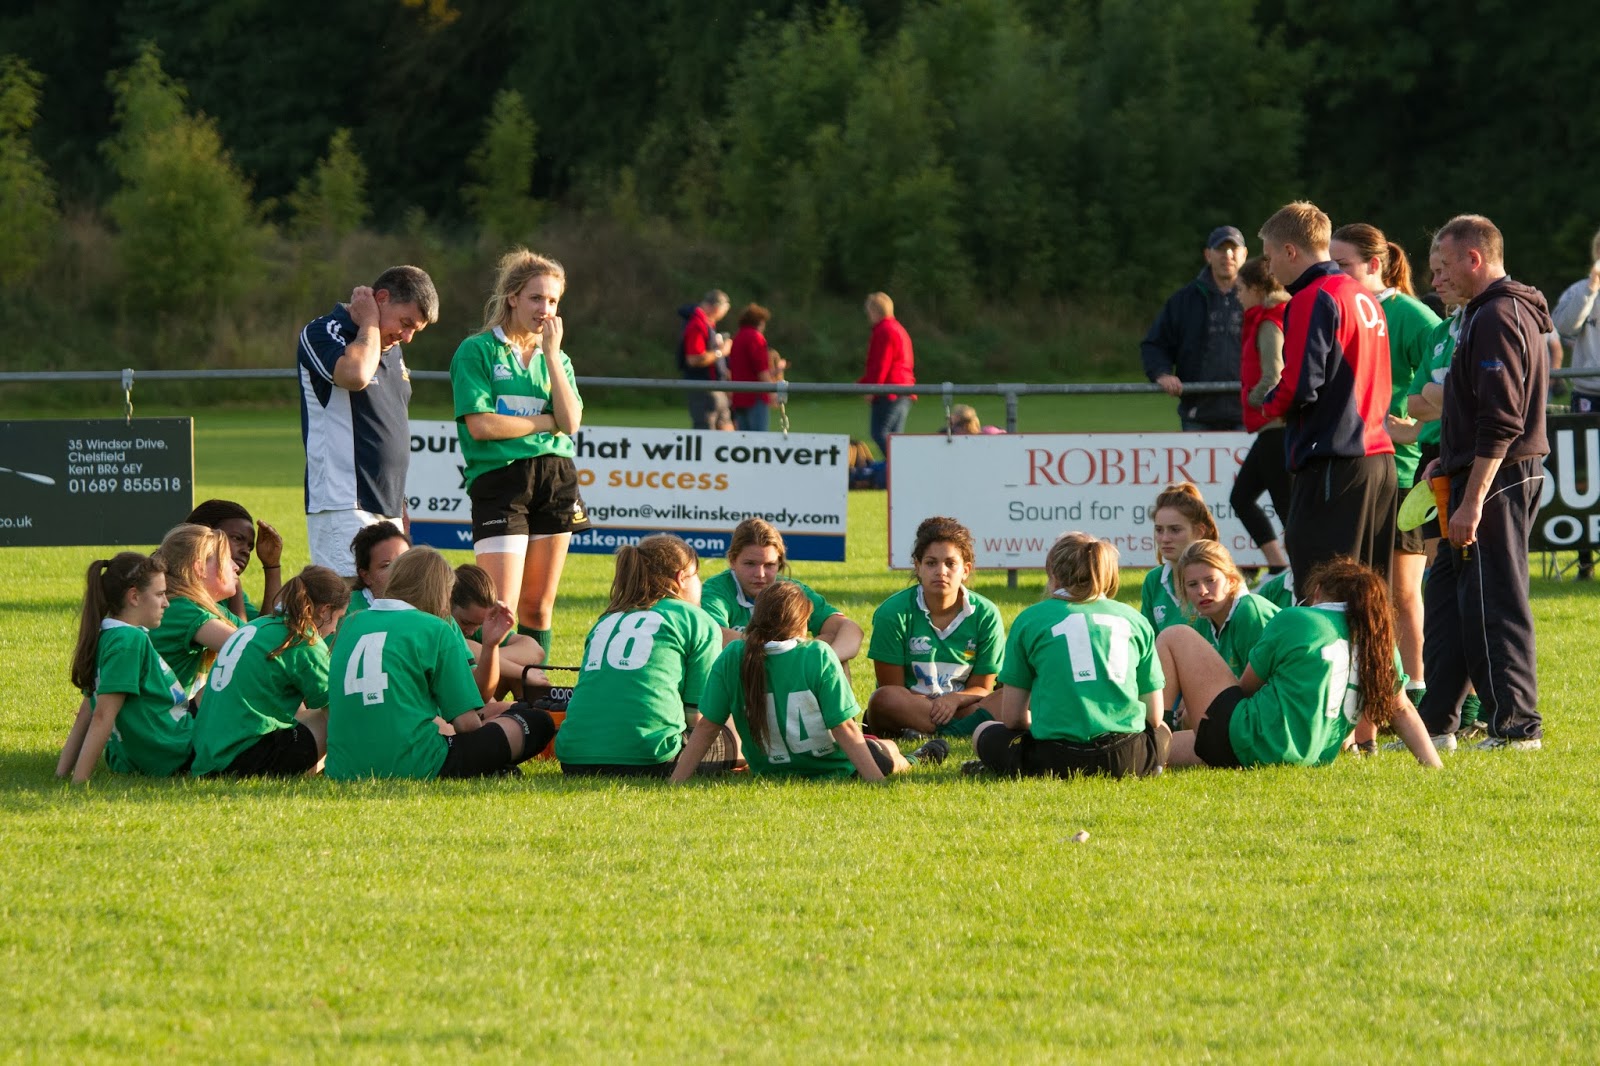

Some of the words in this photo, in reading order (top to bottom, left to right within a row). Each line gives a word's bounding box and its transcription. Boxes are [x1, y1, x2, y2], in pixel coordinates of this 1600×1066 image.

[68, 439, 83, 451] 35
[86, 438, 133, 450] Windsor
[573, 432, 631, 459] hat
[642, 435, 702, 462] will
[714, 444, 840, 466] convert
[68, 451, 126, 463] Chelsfield
[68, 464, 95, 475] Kent
[97, 463, 119, 475] BR6
[122, 462, 143, 474] 6EY
[69, 478, 118, 493] 01689
[123, 477, 181, 492] 855518
[608, 469, 729, 491] success
[428, 497, 462, 511] 827
[1008, 500, 1082, 521] Sound
[1090, 500, 1125, 521] for
[585, 610, 664, 672] 18
[1051, 612, 1133, 684] 17
[211, 625, 257, 692] 9
[344, 631, 389, 706] 4
[760, 688, 836, 764] 14
